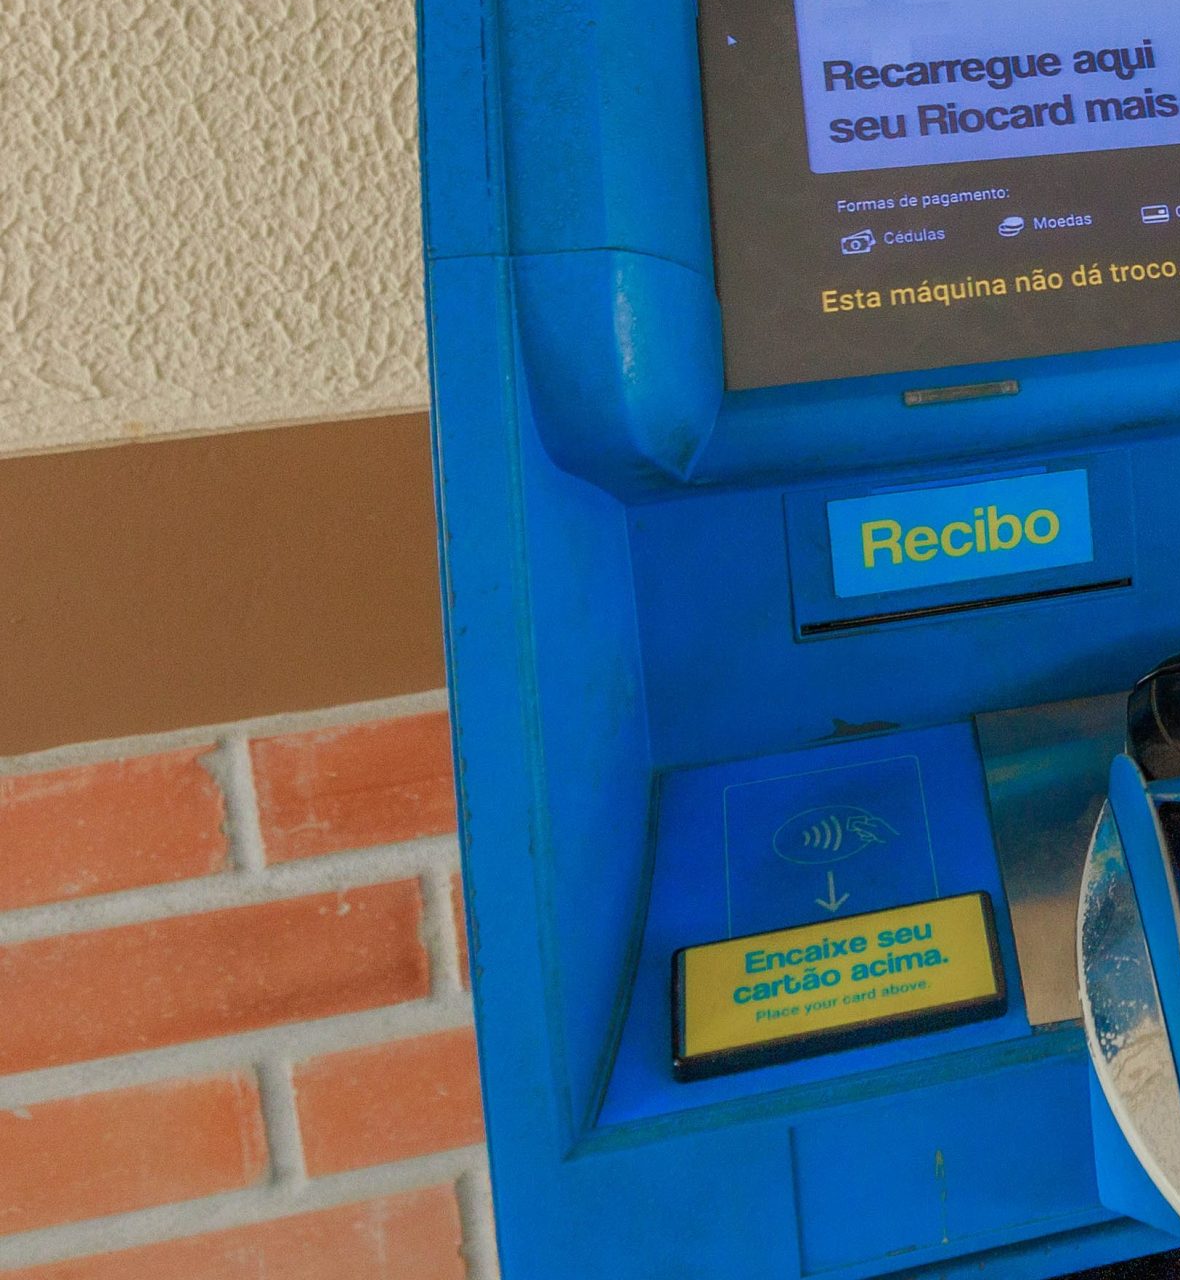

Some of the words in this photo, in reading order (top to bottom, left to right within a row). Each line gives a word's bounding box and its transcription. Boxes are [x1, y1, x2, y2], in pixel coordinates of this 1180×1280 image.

[822, 50, 1062, 92] Recarregue
[1073, 39, 1156, 80] aqui
[829, 115, 907, 144] seu
[916, 94, 1075, 137] Riocard
[1084, 88, 1180, 123] mais
[836, 195, 895, 214] Formas
[900, 193, 918, 208] de
[922, 187, 1010, 210] pagamento:
[883, 226, 946, 247] Cédulas
[1033, 212, 1092, 231] Moedas
[821, 288, 882, 314] Esta
[890, 275, 1008, 309] máquina
[1014, 269, 1064, 294] não
[1071, 263, 1103, 288] dá
[861, 505, 1060, 569] Recibo
[744, 935, 868, 974] Encaixe
[877, 922, 933, 948] seu
[732, 966, 841, 1005] cartão
[850, 947, 949, 982] acima.
[755, 1006, 799, 1022] Place
[803, 997, 838, 1017] your
[842, 987, 877, 1006] card
